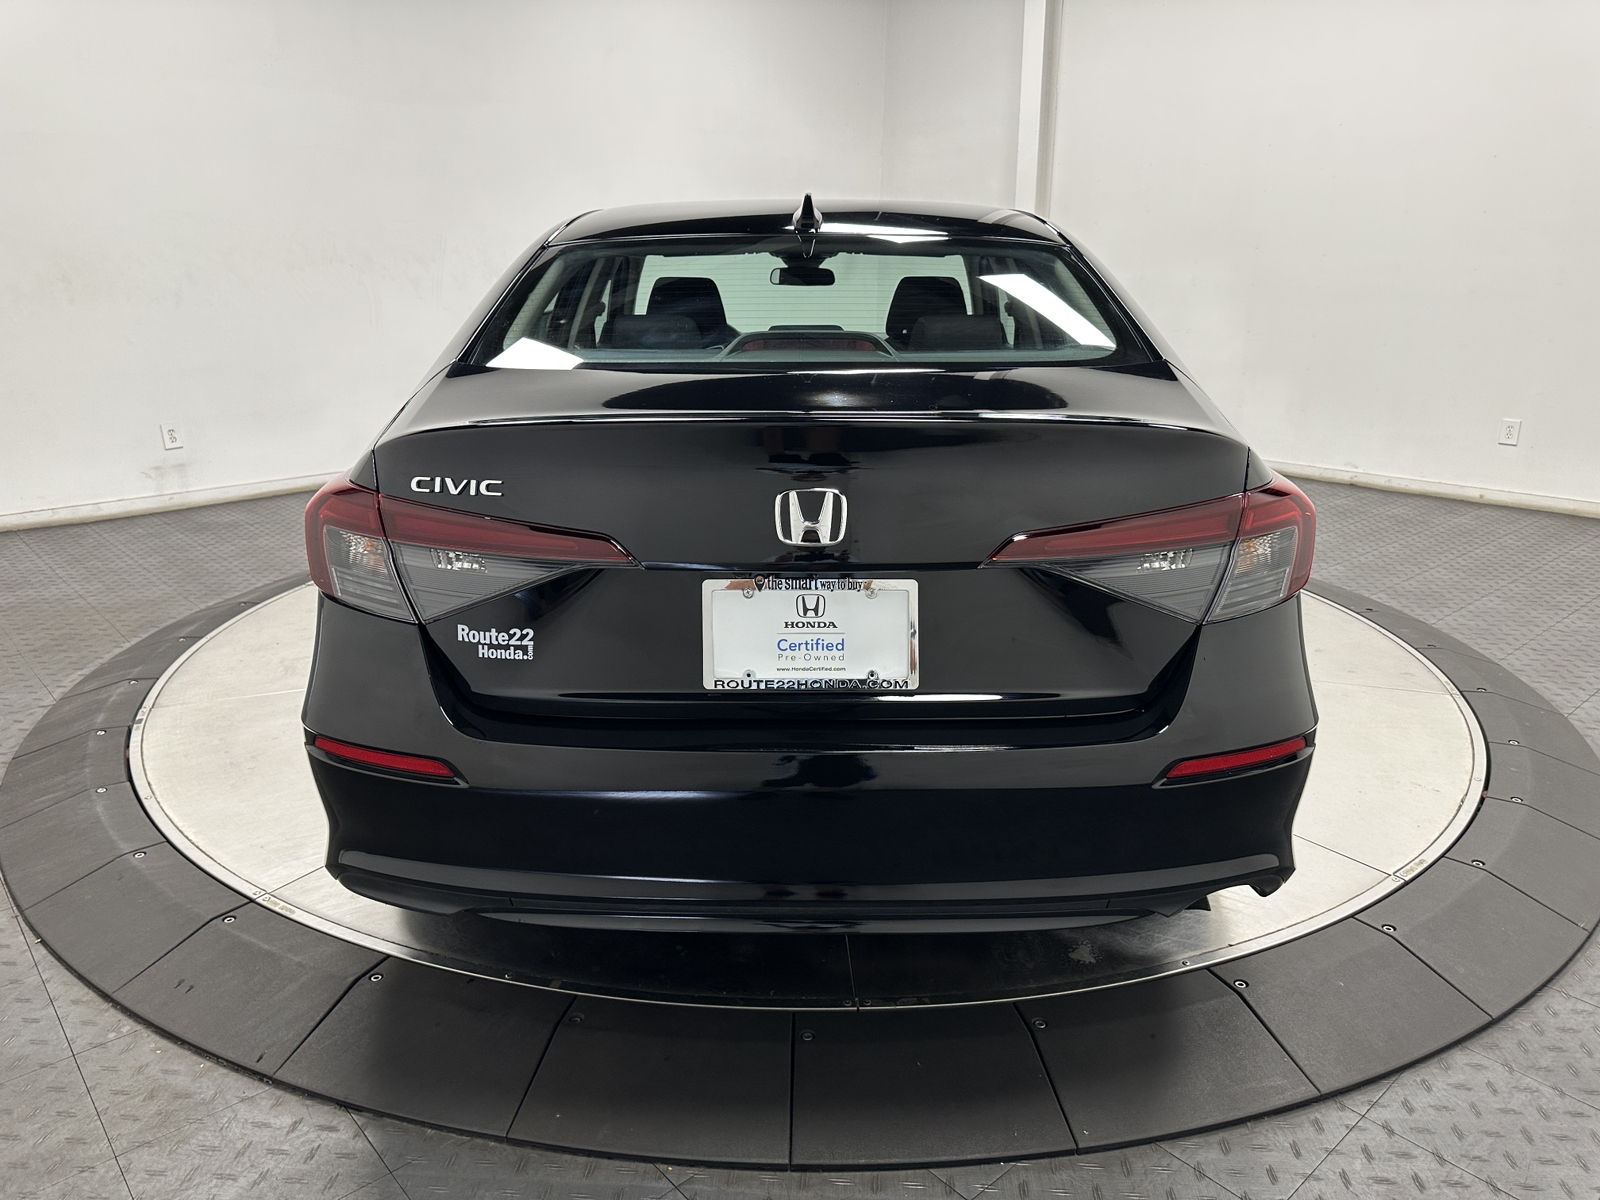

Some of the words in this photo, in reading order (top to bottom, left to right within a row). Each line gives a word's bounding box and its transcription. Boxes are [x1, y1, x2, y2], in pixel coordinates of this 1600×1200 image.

[410, 476, 503, 496] CIVIC
[766, 574, 783, 590] the
[784, 573, 818, 590] smart
[820, 580, 836, 592] way
[837, 579, 846, 590] to
[847, 577, 863, 592] buy
[783, 621, 838, 629] HONDA
[457, 623, 534, 645] Route22
[777, 637, 845, 652] Certified
[777, 653, 845, 662] Pre-Owned
[713, 679, 909, 690] ROUTE22HONDA.COM
